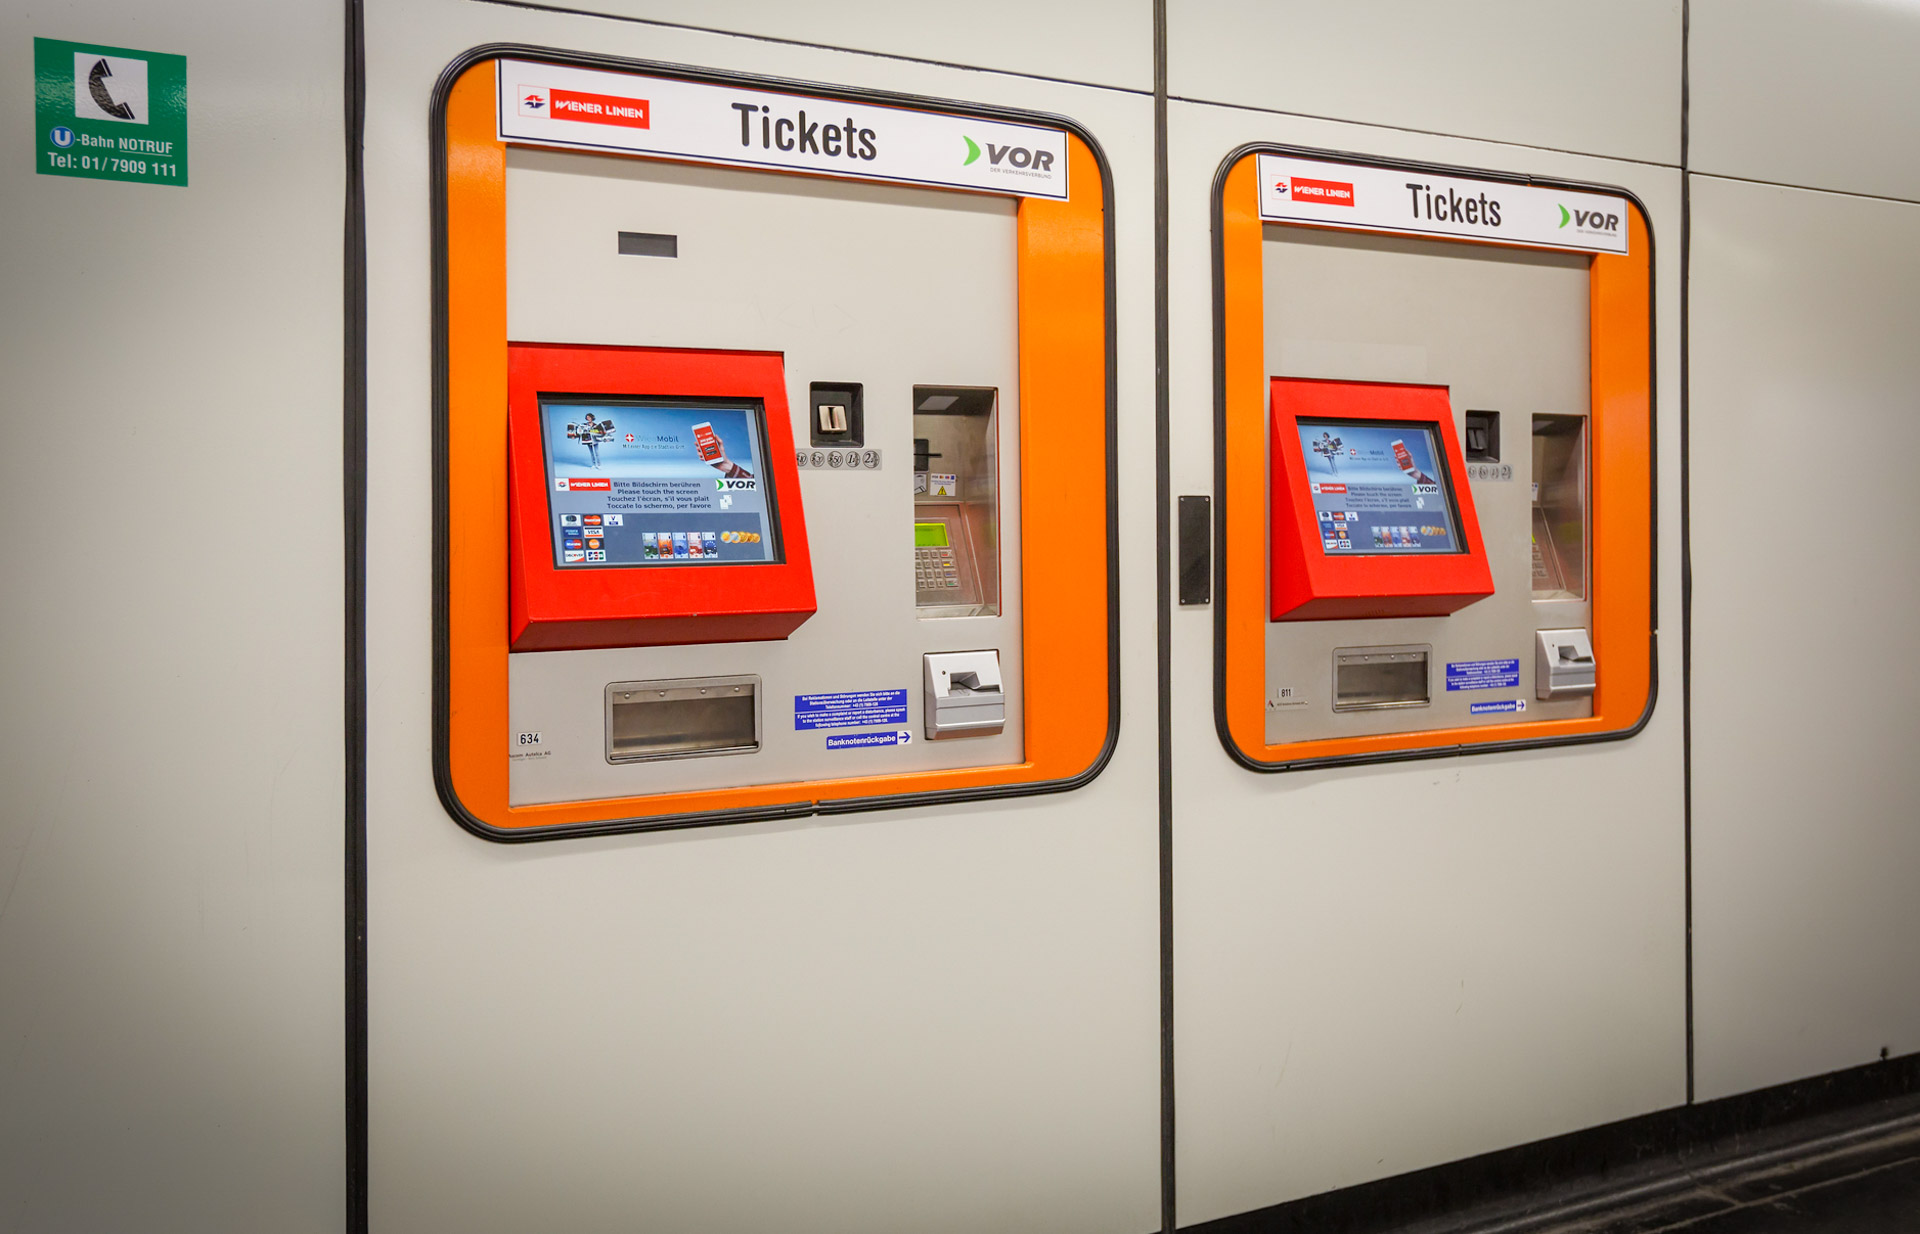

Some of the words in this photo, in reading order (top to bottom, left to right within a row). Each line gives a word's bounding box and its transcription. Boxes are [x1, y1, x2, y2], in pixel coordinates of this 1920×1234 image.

[555, 100, 602, 114] WIENER
[606, 105, 644, 119] LINIEN
[732, 102, 877, 161] Tickets
[119, 138, 173, 154] NOTRUF
[47, 152, 78, 168] Tel:
[111, 158, 146, 174] 7909
[152, 162, 176, 177] 111
[985, 142, 1054, 172] VOR
[1294, 186, 1324, 196] WIENER
[1326, 188, 1350, 198] LINIEN
[1406, 183, 1502, 227] Tickets
[1573, 209, 1619, 231] VOR
[726, 480, 756, 489] VOR
[520, 733, 540, 744] 634
[828, 735, 896, 747] Banknotenrückgabe
